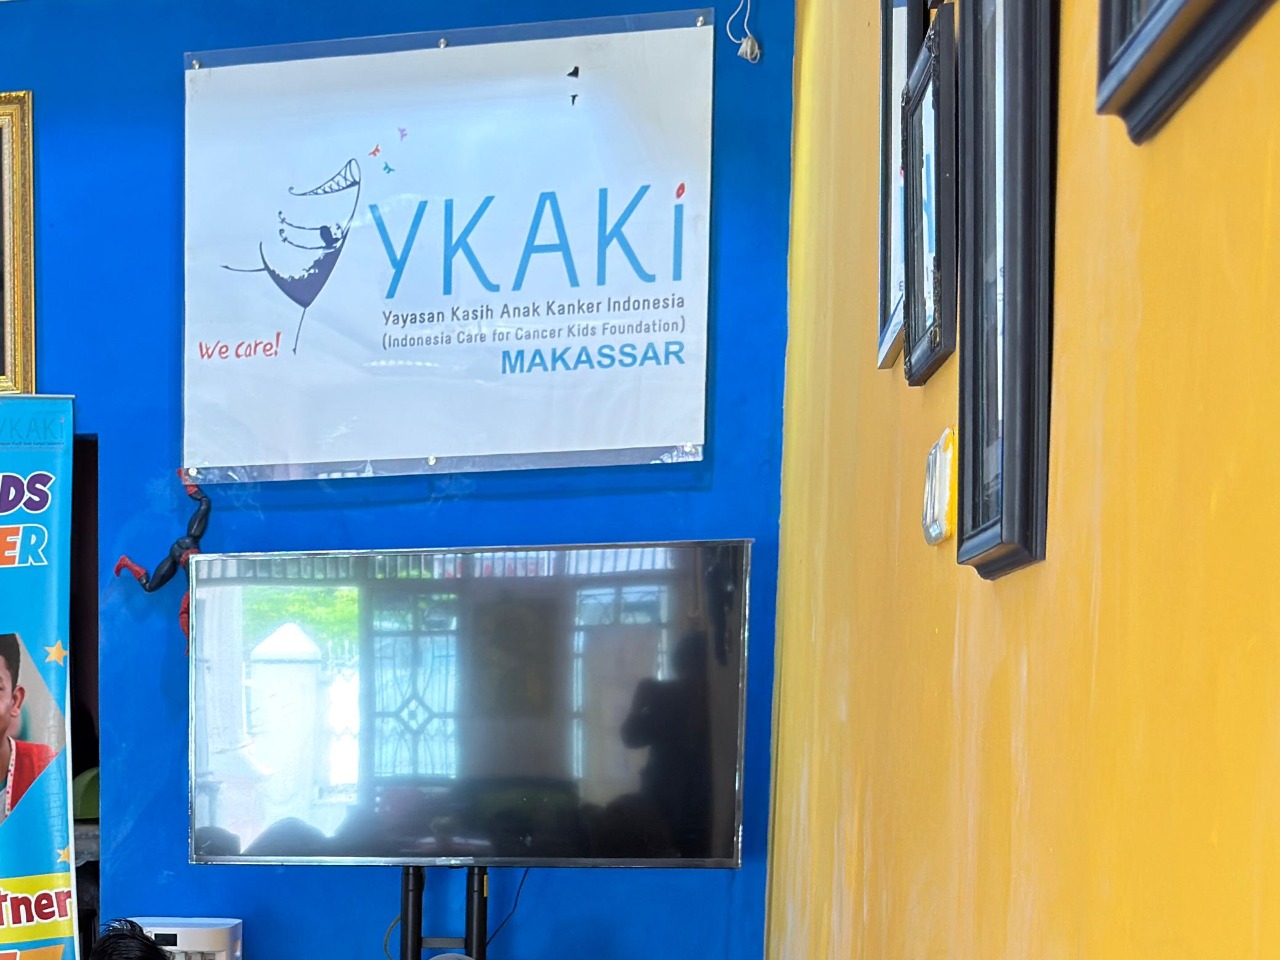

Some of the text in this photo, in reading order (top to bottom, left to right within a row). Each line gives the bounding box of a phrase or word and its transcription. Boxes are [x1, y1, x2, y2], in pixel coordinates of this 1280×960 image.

[369, 182, 686, 299] YKAKi
[382, 294, 685, 328] Yayasan Kasih Anak Kanker Indonesia
[199, 332, 281, 360] We care!
[382, 316, 686, 351] (Indonesia Care for Cancer Kids Foundation)
[502, 341, 685, 374] MAKASSAR
